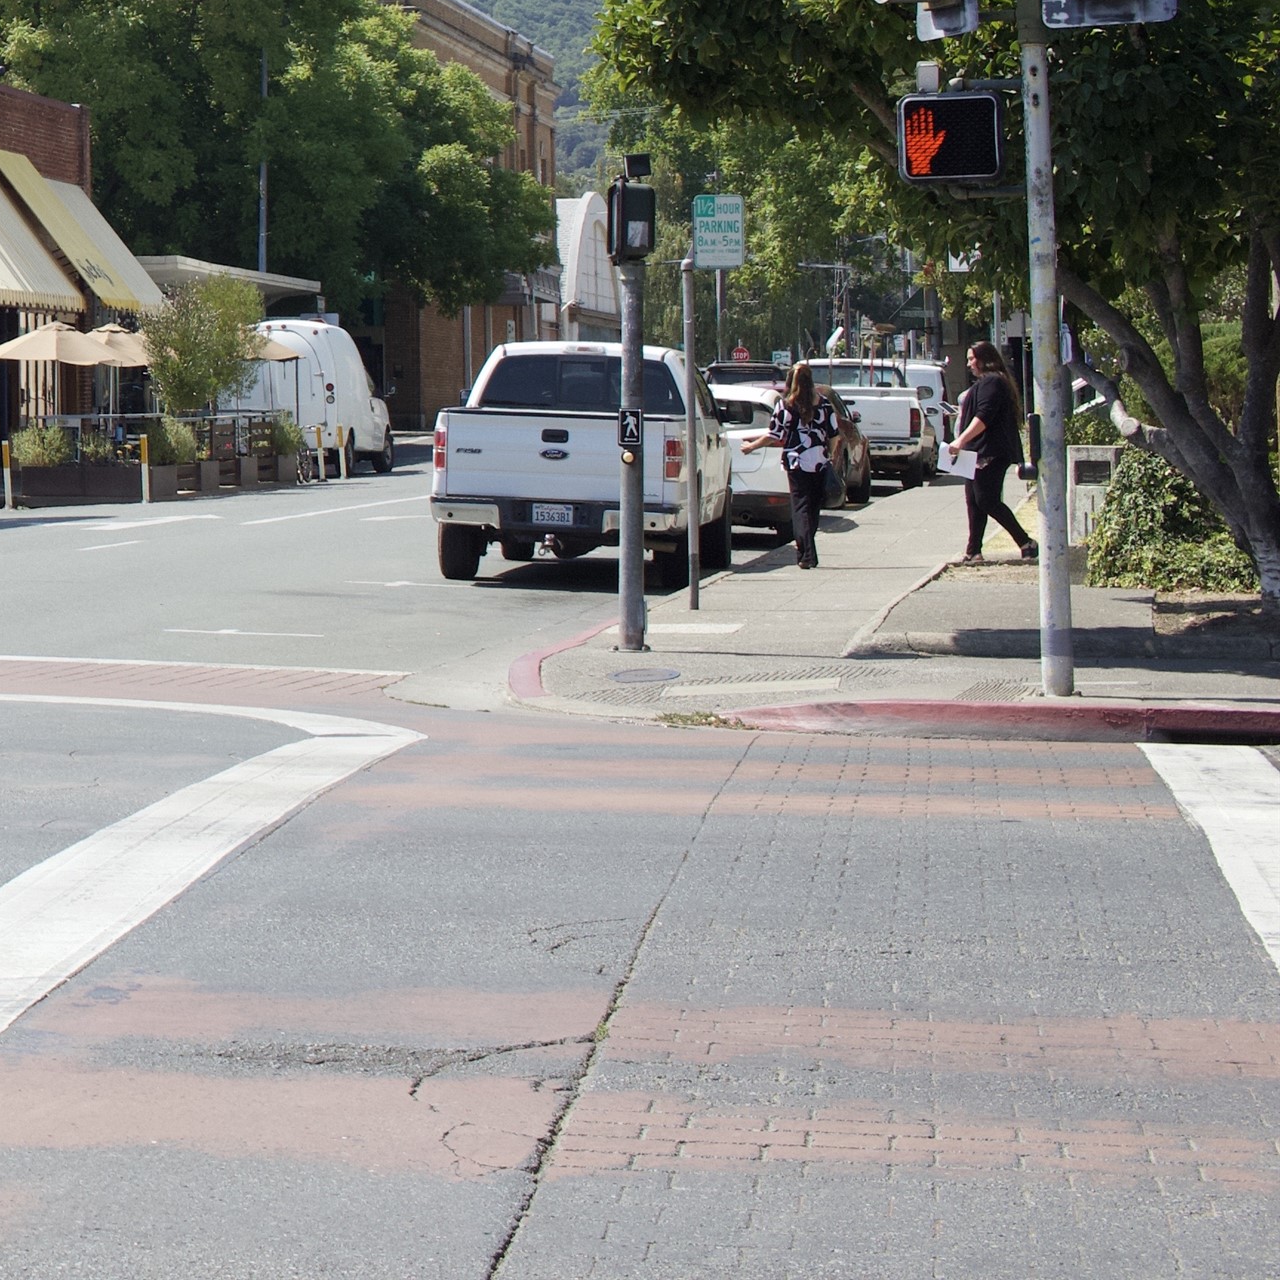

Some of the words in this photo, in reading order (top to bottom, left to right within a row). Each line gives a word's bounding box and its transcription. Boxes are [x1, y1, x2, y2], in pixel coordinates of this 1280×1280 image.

[716, 203, 740, 215] HOUR
[699, 220, 740, 233] PARKING
[733, 351, 749, 360] STOP
[534, 510, 571, 523] 15363B1
